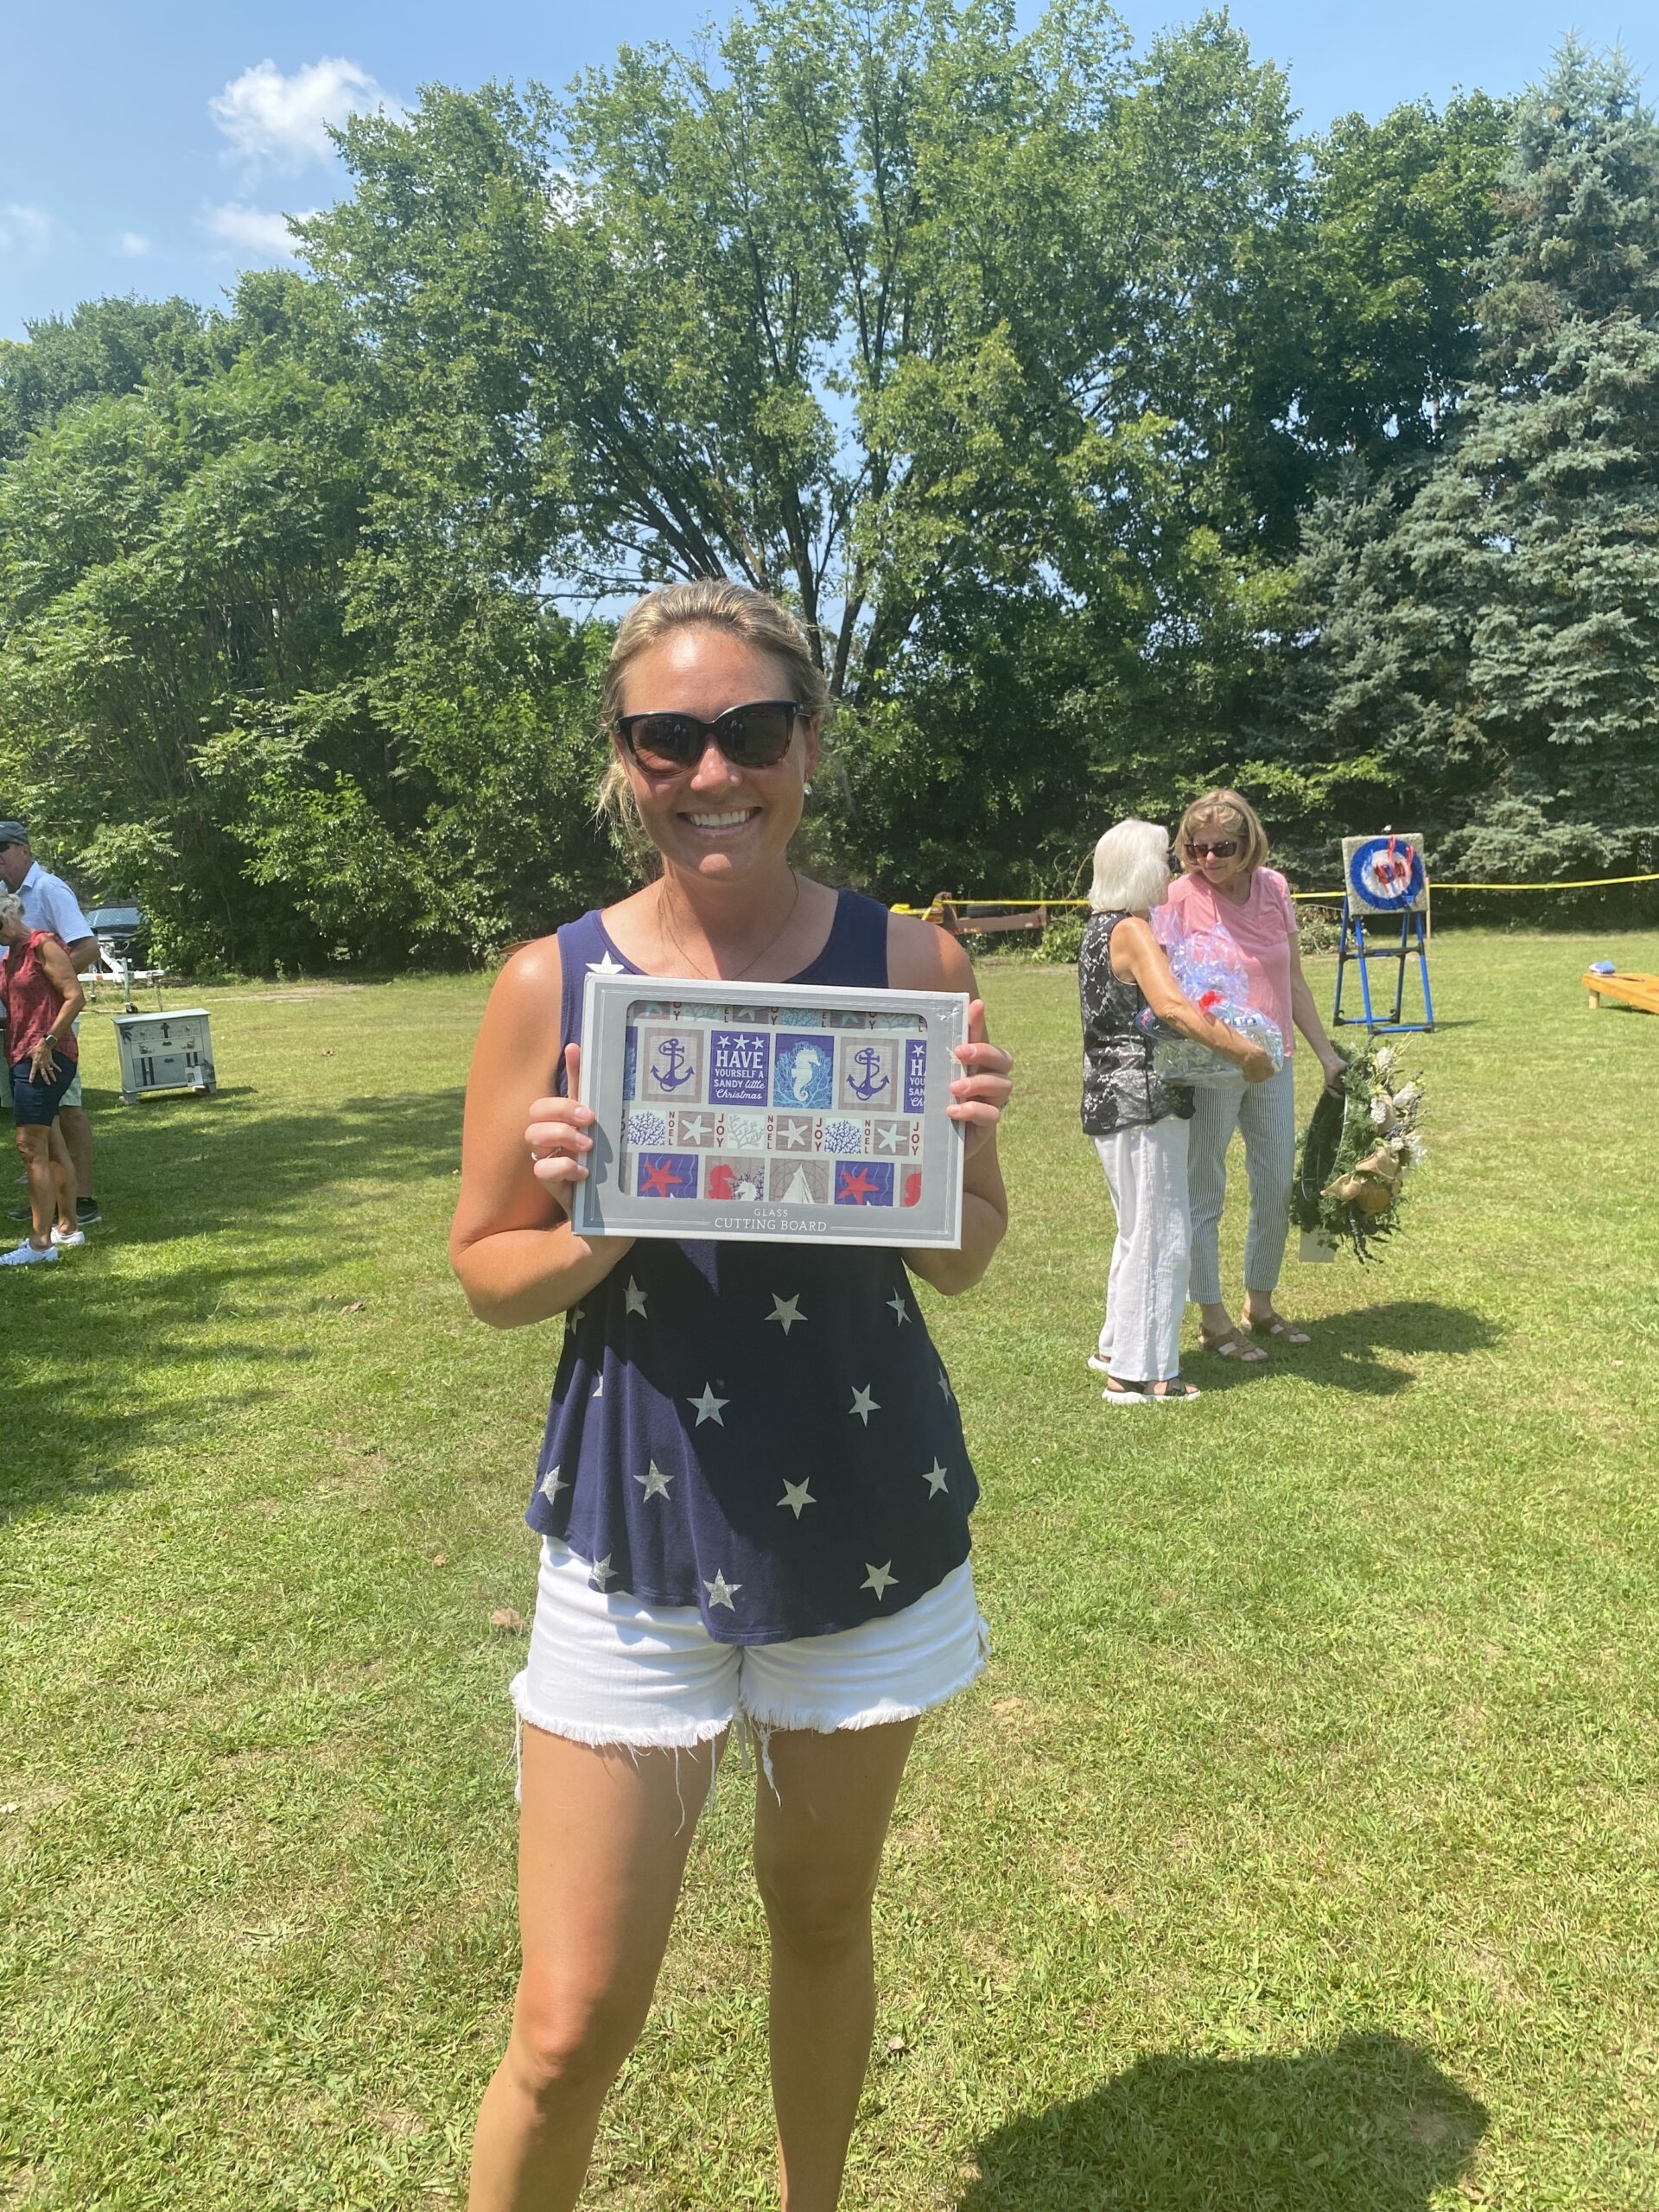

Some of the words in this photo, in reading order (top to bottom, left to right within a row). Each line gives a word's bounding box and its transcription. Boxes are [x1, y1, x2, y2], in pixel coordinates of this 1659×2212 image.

[716, 1050, 764, 1068] HAVE
[715, 1068, 757, 1077] YOURSELF
[714, 1079, 743, 1088] SANDY
[744, 1079, 765, 1090] little
[715, 1089, 763, 1100] Christmas
[911, 1097, 925, 1107] Ch
[716, 1113, 725, 1147] JOY
[912, 1122, 920, 1156] JOY
[753, 1208, 788, 1217] GLASS
[715, 1217, 776, 1230] CUTTING
[780, 1220, 827, 1232] BOARD
